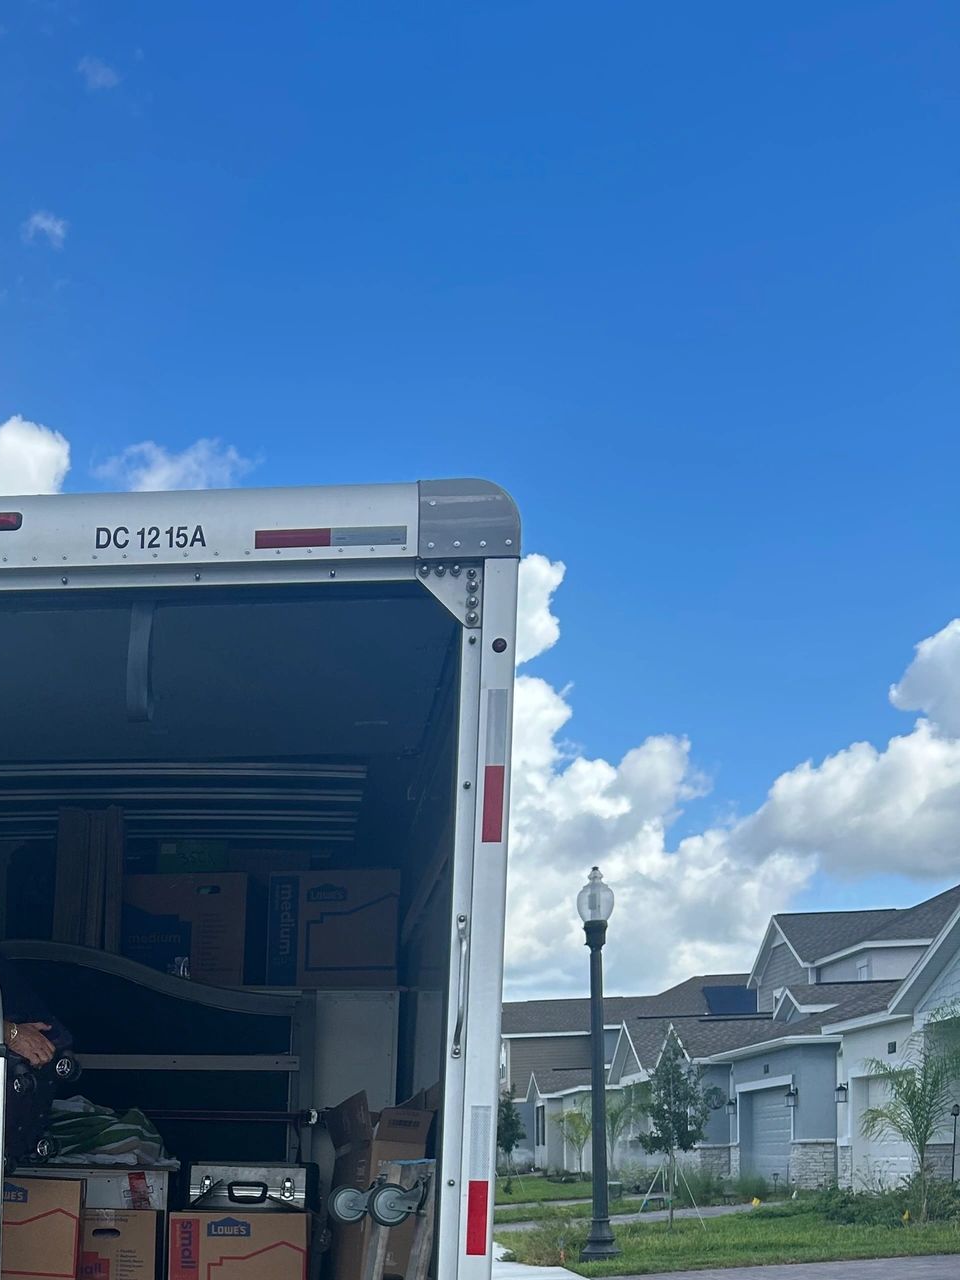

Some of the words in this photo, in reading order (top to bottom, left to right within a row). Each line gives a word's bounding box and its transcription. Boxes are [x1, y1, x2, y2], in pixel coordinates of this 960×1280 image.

[95, 526, 129, 549] DC
[136, 525, 207, 549] 1215A
[279, 883, 297, 956] medium
[128, 932, 182, 945] medium
[3, 1191, 24, 1201] WE'S
[211, 1223, 247, 1235] LOWE'S
[180, 1220, 197, 1269] small
